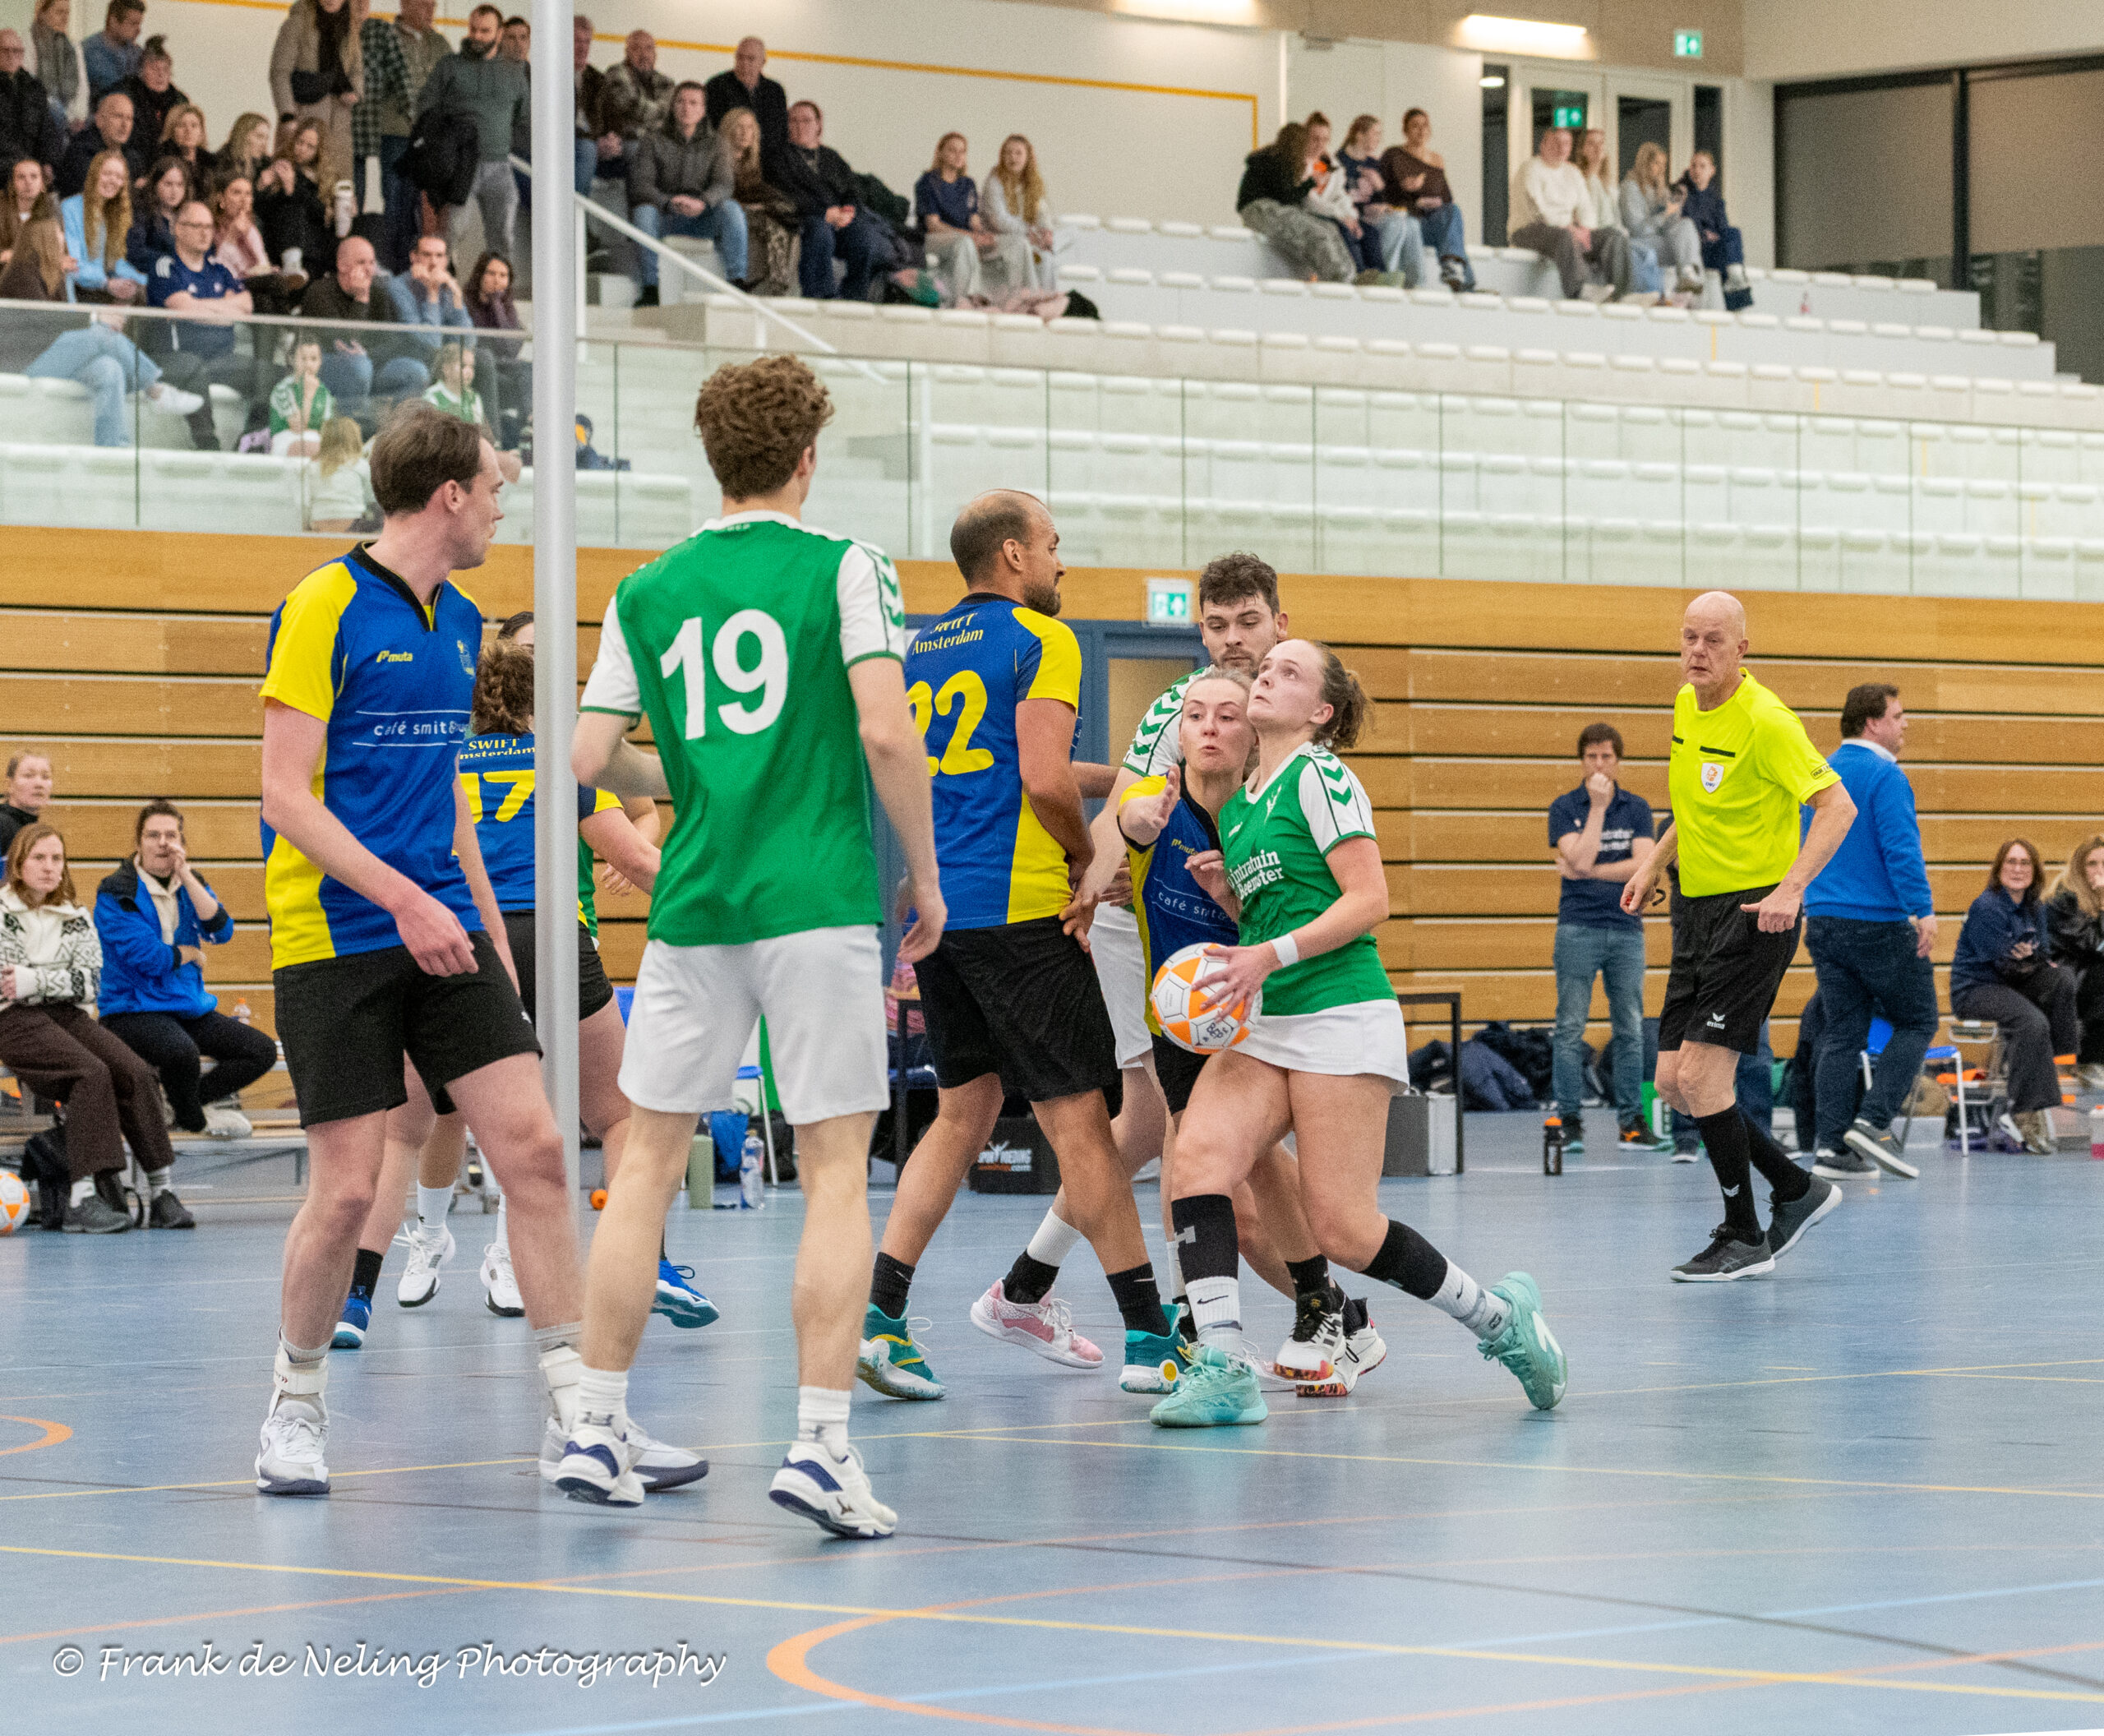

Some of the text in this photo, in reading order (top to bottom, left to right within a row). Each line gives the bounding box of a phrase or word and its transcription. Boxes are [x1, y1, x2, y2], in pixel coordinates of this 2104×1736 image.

[911, 629, 984, 656] Amsterdam
[660, 608, 789, 741] 19
[374, 721, 407, 736] café
[459, 747, 535, 760] msterdam
[468, 739, 520, 751] SWIFT
[459, 769, 536, 824] 17
[1230, 848, 1281, 885] intratuin
[1158, 892, 1187, 911] café
[1706, 1021, 1725, 1030] erima
